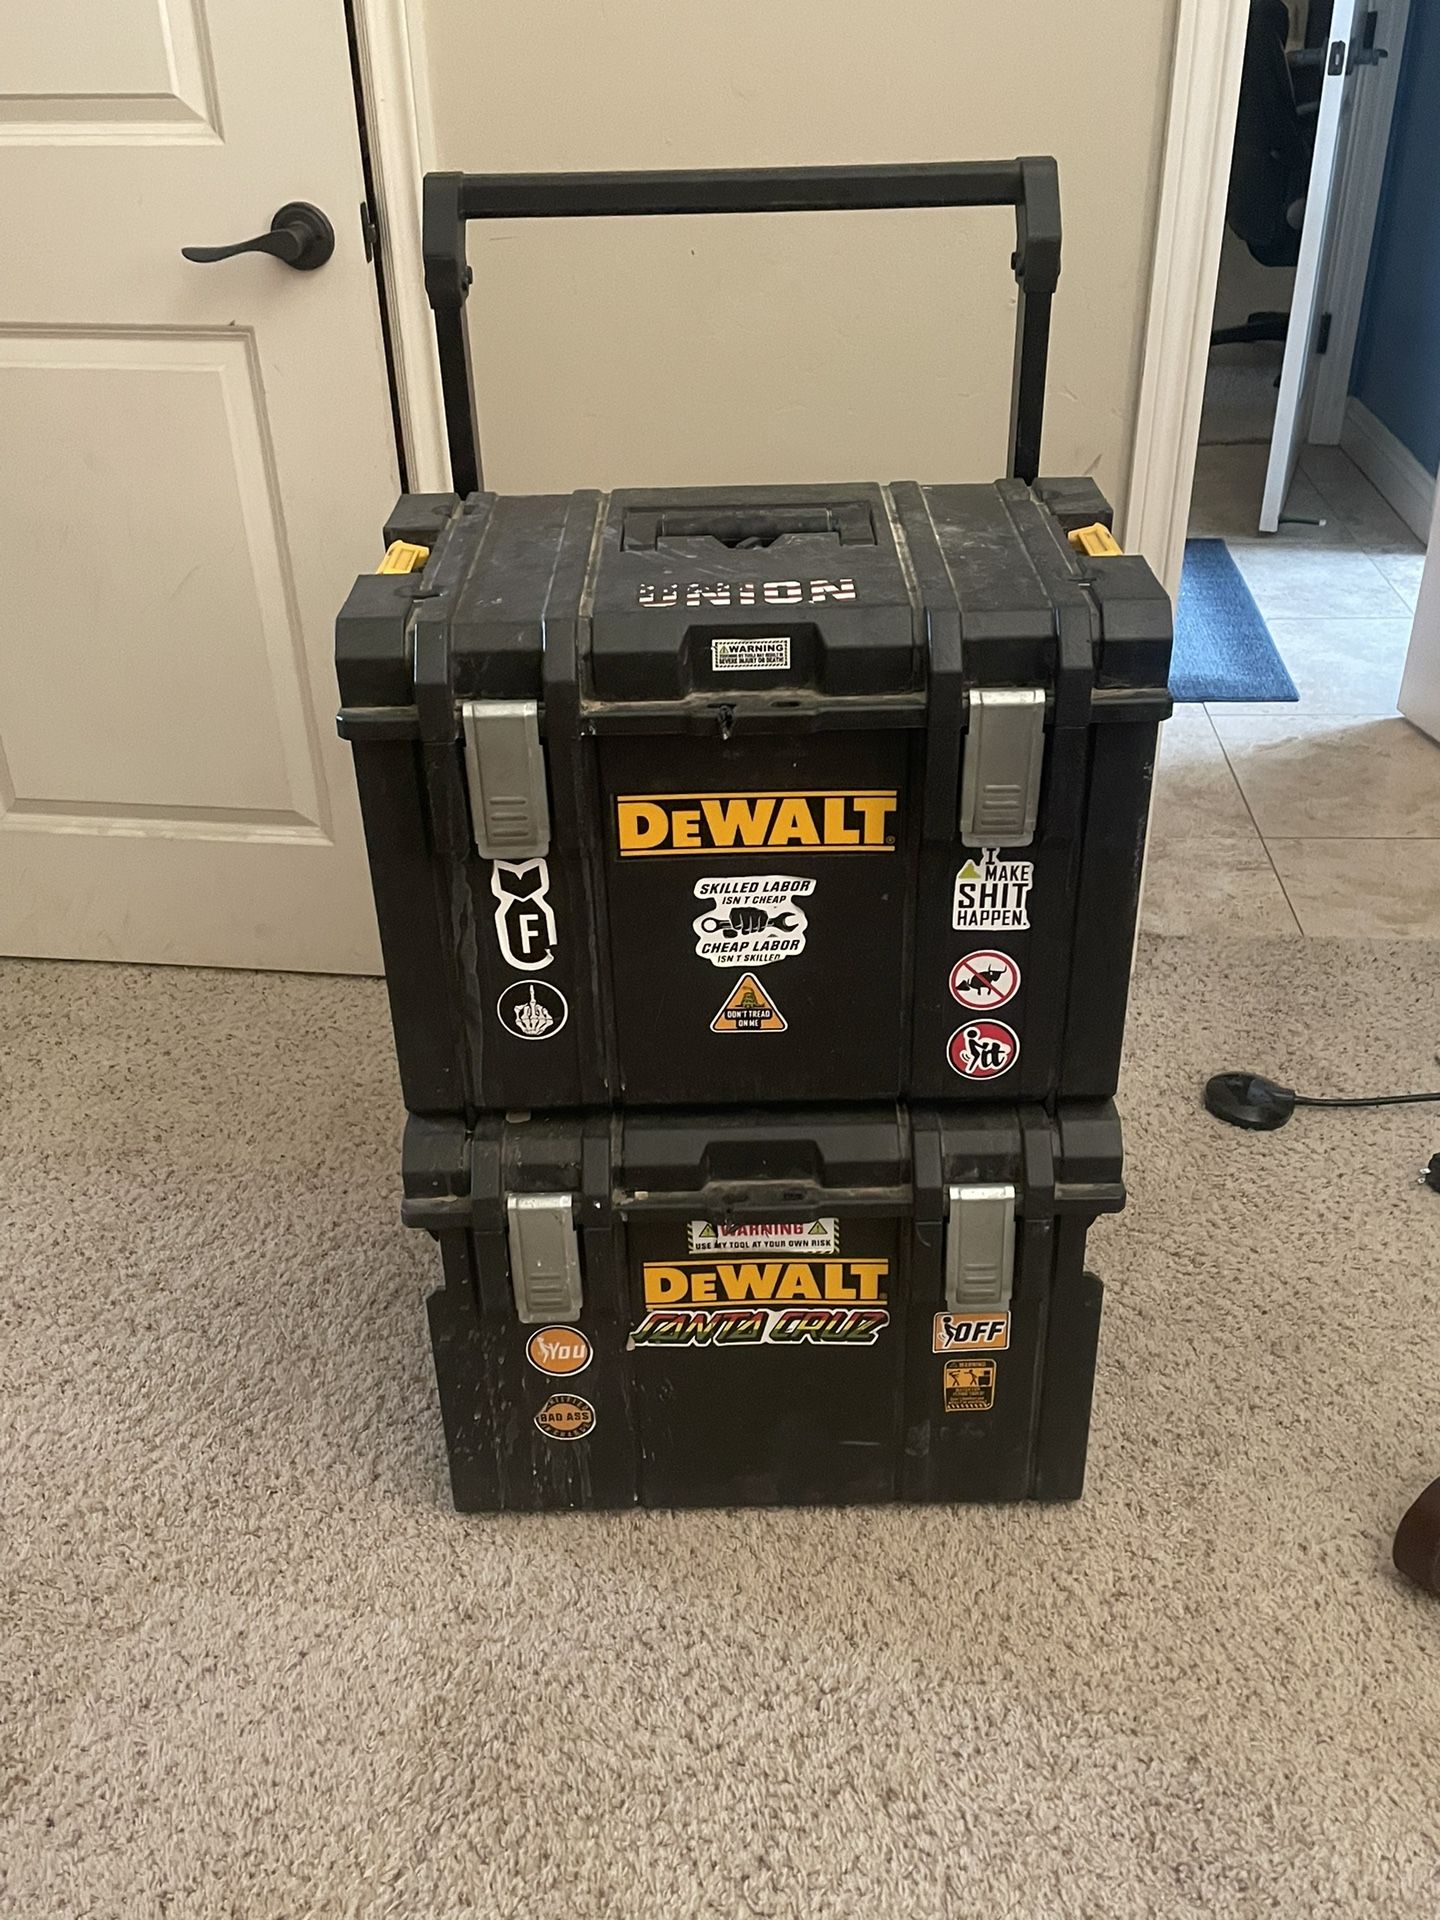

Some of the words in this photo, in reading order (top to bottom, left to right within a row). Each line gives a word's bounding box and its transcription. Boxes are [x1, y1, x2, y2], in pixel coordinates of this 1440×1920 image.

[639, 578, 857, 608] UNION
[729, 644, 784, 653] WARNING
[985, 847, 997, 865] I
[985, 865, 1031, 881] MAKE
[700, 882, 759, 895] SKILLED
[762, 880, 811, 892] LABOR
[722, 895, 749, 905] ISNT
[752, 895, 787, 904] CHEAP
[958, 883, 1029, 909] SHIT
[957, 910, 1027, 926] HAPPEN.
[702, 941, 750, 954] CHEAP
[752, 939, 800, 951] LABOR
[717, 954, 742, 963] ISNT
[727, 1010, 748, 1018] DON'T
[749, 1010, 771, 1018] TREAD
[720, 1223, 804, 1237] WARNING
[714, 1241, 727, 1249] MY
[764, 1240, 786, 1248] YOUR
[789, 1239, 809, 1247] OWN
[811, 1239, 832, 1247] RISK
[633, 1310, 770, 1343] SANTA
[771, 1310, 889, 1343] CRUZ
[954, 1321, 1005, 1342] OFF
[540, 1413, 563, 1422] BAD
[566, 1411, 589, 1421] ASS
